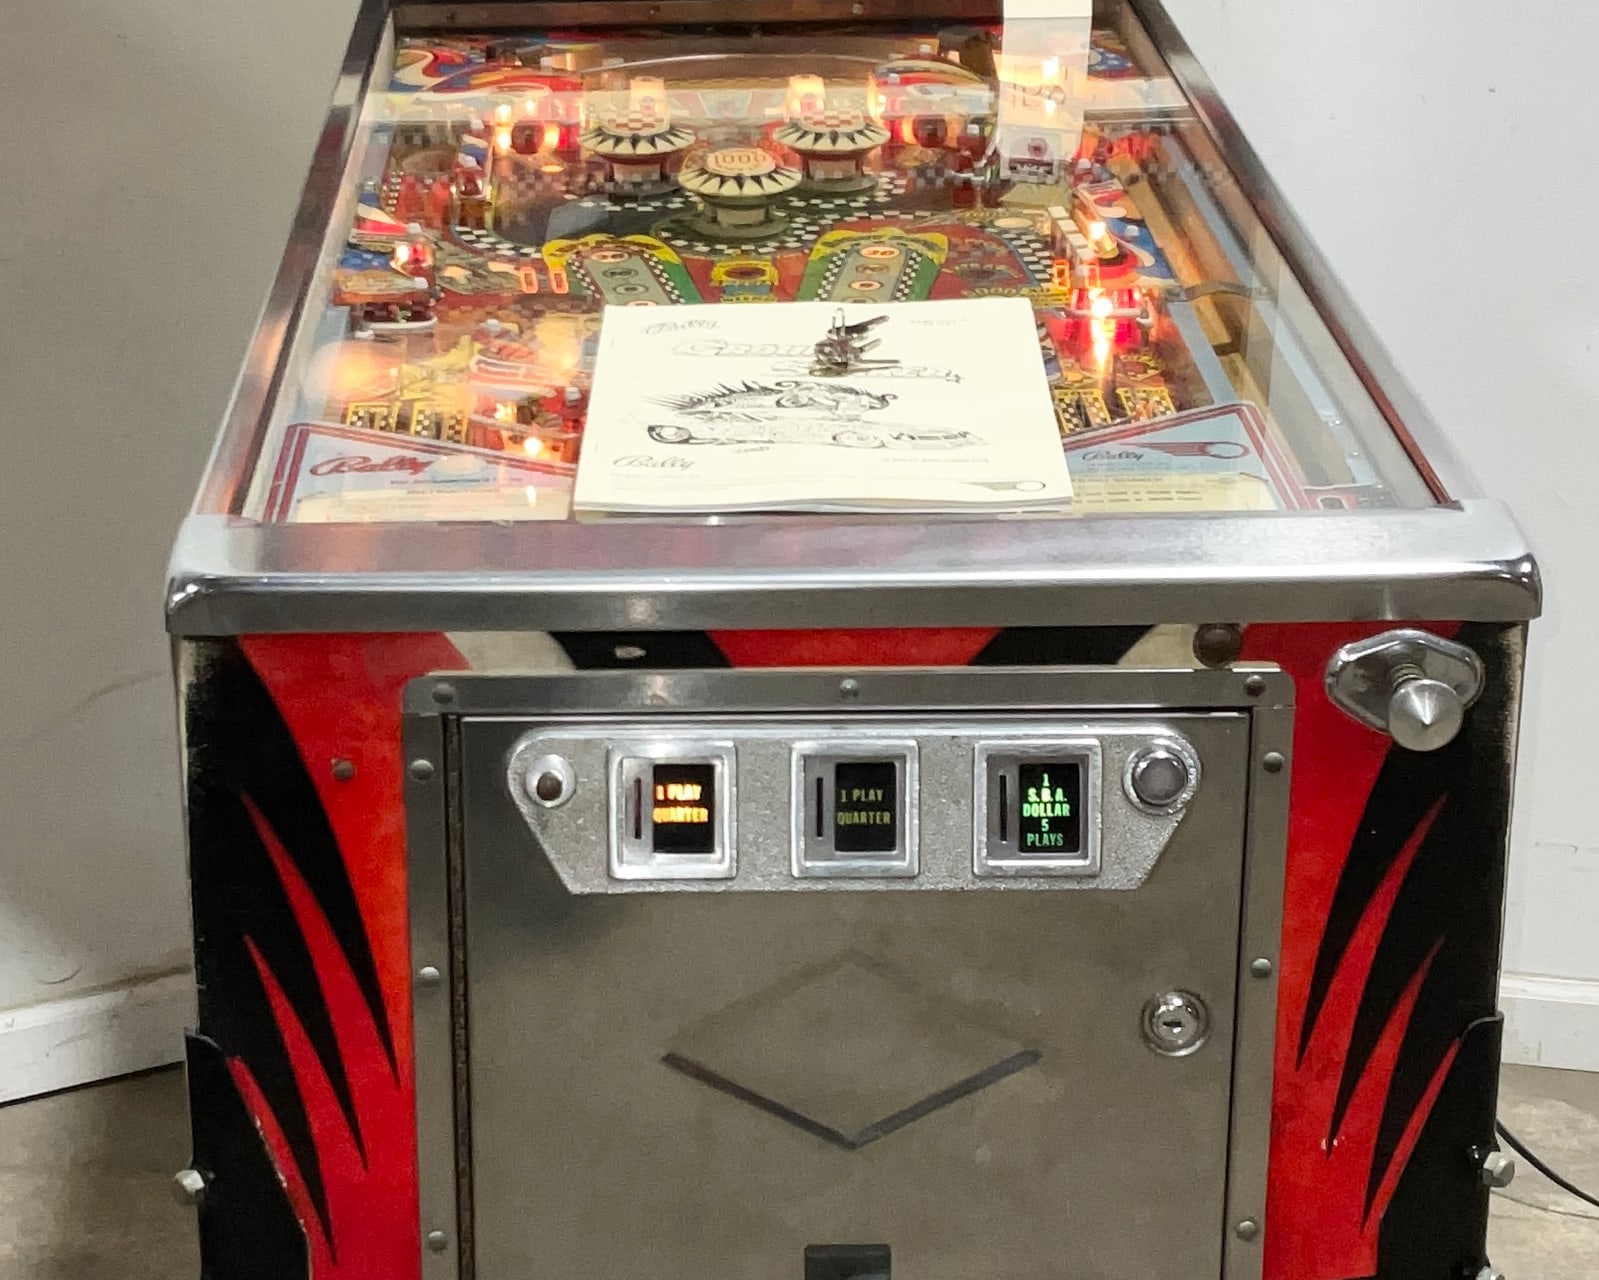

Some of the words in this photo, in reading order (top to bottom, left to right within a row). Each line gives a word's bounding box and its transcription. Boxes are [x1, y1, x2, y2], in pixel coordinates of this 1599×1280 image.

[1042, 772, 1050, 787] 1
[852, 787, 884, 803] PLAY
[1022, 803, 1071, 818] DOLLAR
[836, 811, 891, 826] QUARTER
[1041, 818, 1050, 832] 5
[1026, 832, 1065, 847] PLAYS
